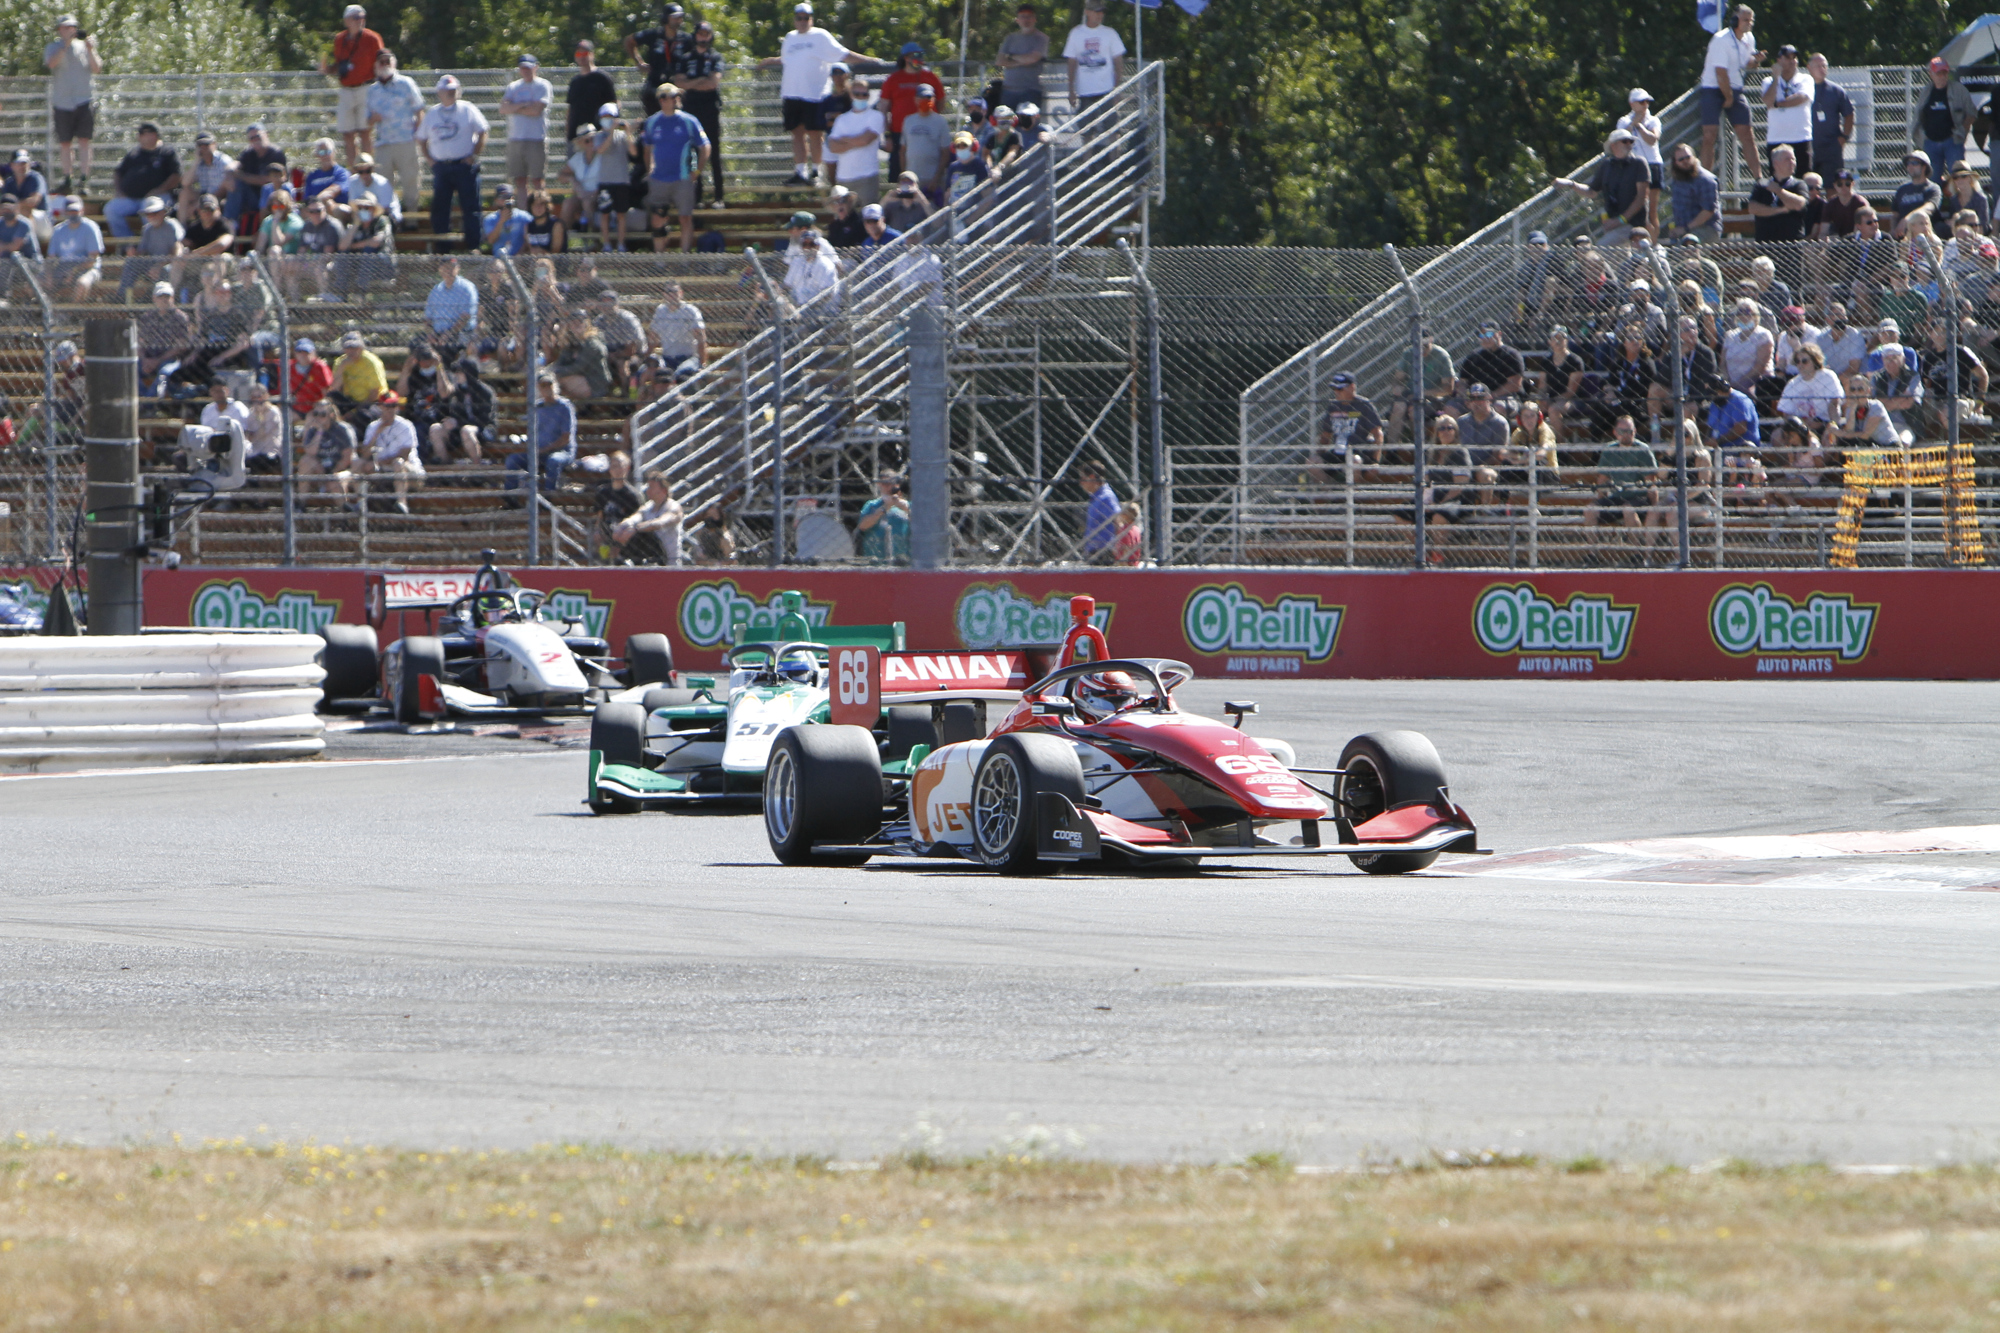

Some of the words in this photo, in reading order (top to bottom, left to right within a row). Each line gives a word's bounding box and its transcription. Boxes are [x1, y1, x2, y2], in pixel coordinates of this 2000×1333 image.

[385, 580, 438, 598] TING
[1191, 594, 1334, 652] O'Reilly
[1481, 592, 1627, 652] O'Reilly
[1718, 592, 1867, 652] O'Reilly
[883, 654, 1027, 681] ANIAL
[1226, 657, 1257, 671] AUTO
[1261, 657, 1300, 673] PARTS
[1518, 657, 1550, 672] AUTO
[1553, 657, 1593, 673] PARTS
[1756, 657, 1789, 673] AUTO
[1792, 657, 1833, 673] PARTS
[838, 650, 869, 705] 68
[735, 722, 779, 736] 51
[1215, 755, 1287, 775] 68
[1053, 830, 1083, 841] COOPER
